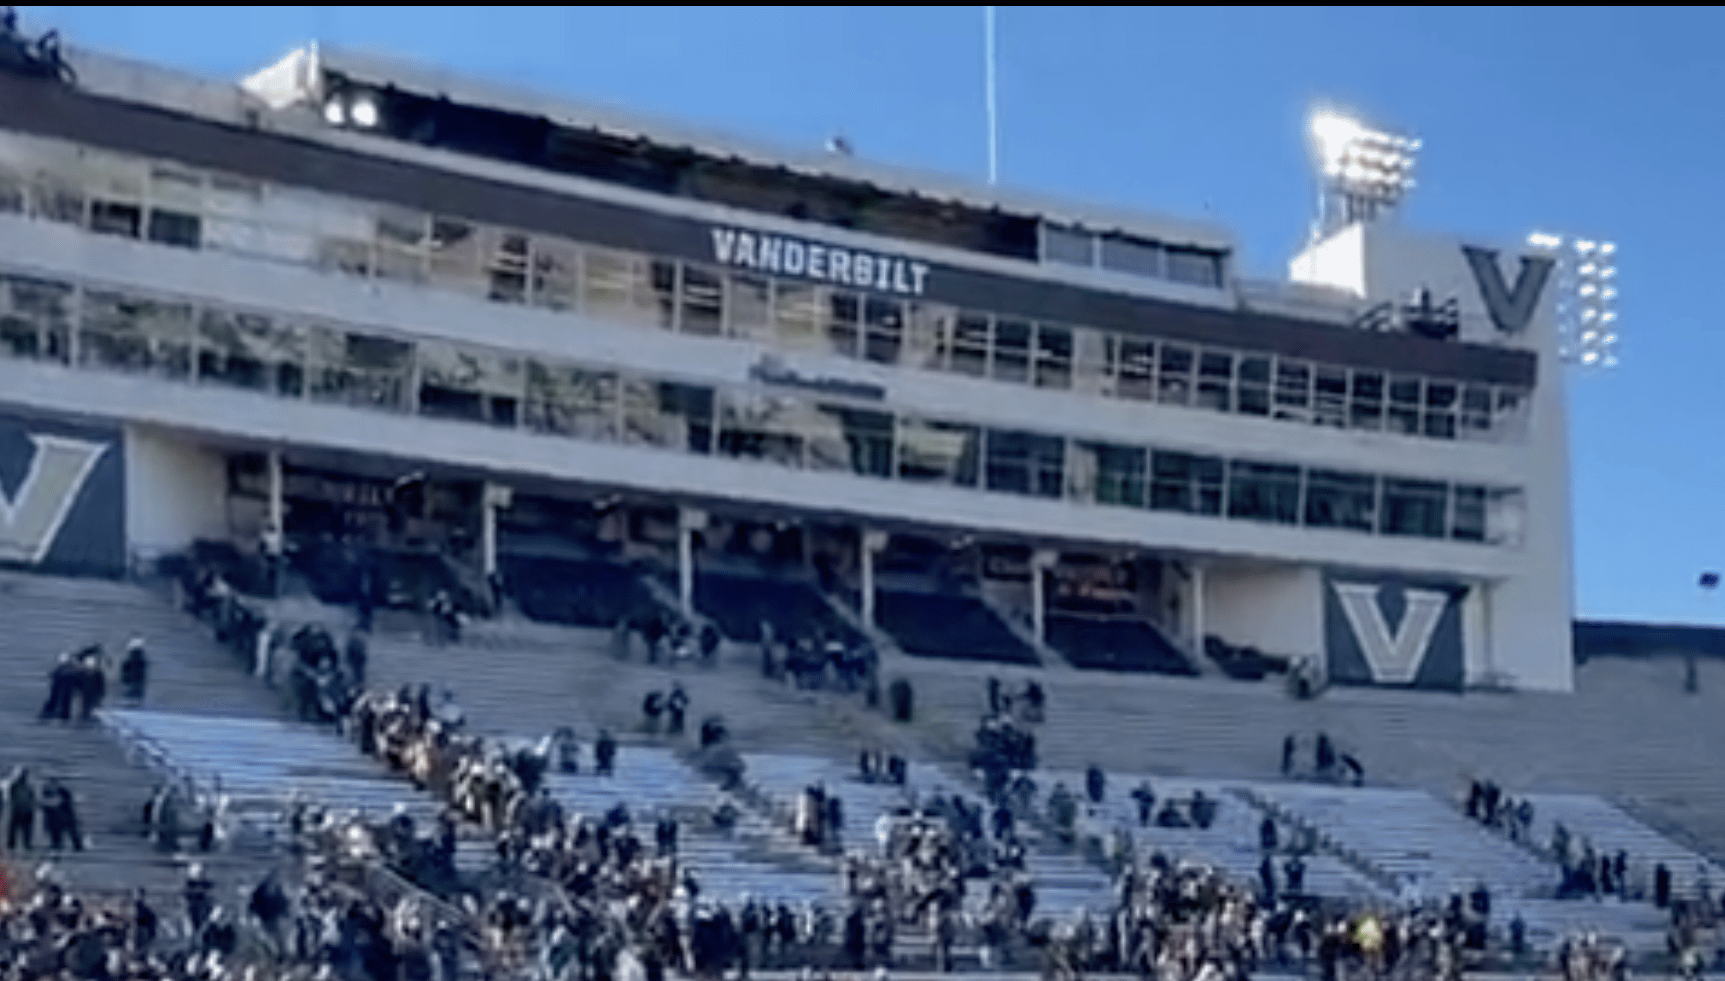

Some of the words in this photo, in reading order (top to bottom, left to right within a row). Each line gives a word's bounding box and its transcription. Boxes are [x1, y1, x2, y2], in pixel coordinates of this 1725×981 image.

[711, 228, 931, 296] VANDERBILT
[1460, 243, 1556, 336] V
[1330, 580, 1450, 683] V
